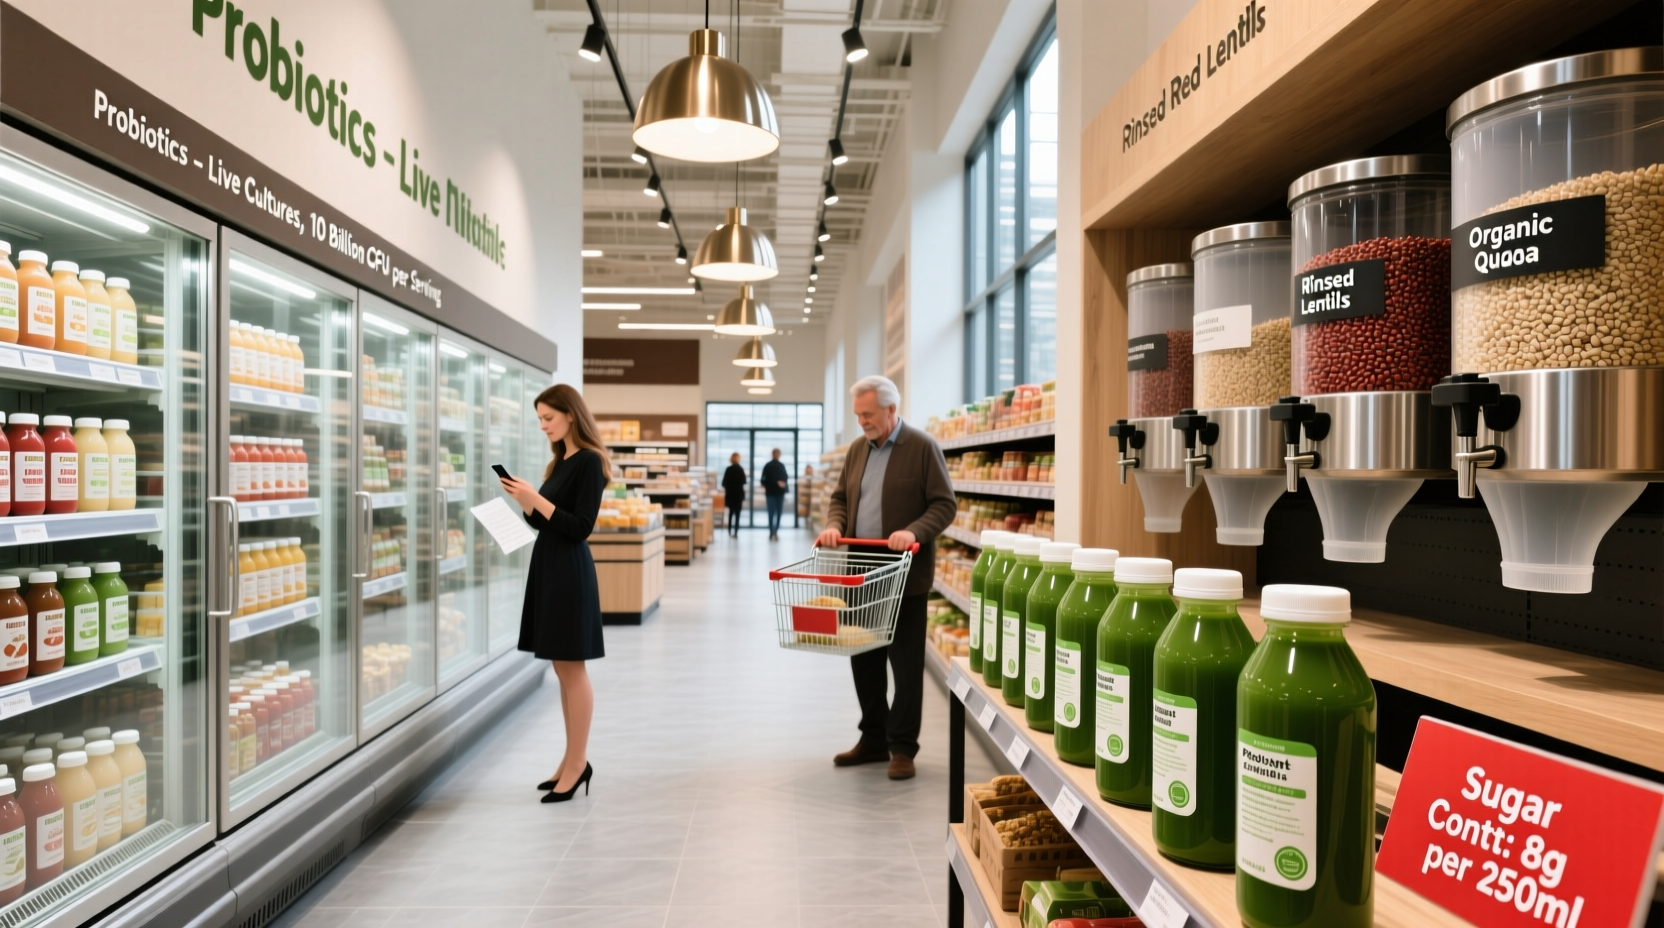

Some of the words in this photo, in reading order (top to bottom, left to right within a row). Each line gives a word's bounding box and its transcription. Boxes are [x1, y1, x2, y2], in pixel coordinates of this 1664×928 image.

[1122, 88, 1166, 153] Rinsed
[1170, 53, 1201, 111] Red
[94, 88, 188, 166] Probiotics
[208, 155, 241, 195] Live
[244, 176, 305, 235] Cultures,
[310, 212, 326, 242] 10
[366, 246, 390, 276] CFU
[392, 266, 409, 288] per
[400, 138, 440, 217] Live
[1469, 213, 1553, 249] Organic
[1301, 268, 1355, 295] Rinsed
[1301, 290, 1351, 315] Lentils
[1461, 766, 1563, 828] Sugar
[1421, 843, 1473, 882] per
[1476, 860, 1585, 928] 250ml
[1520, 835, 1567, 889] 8g
